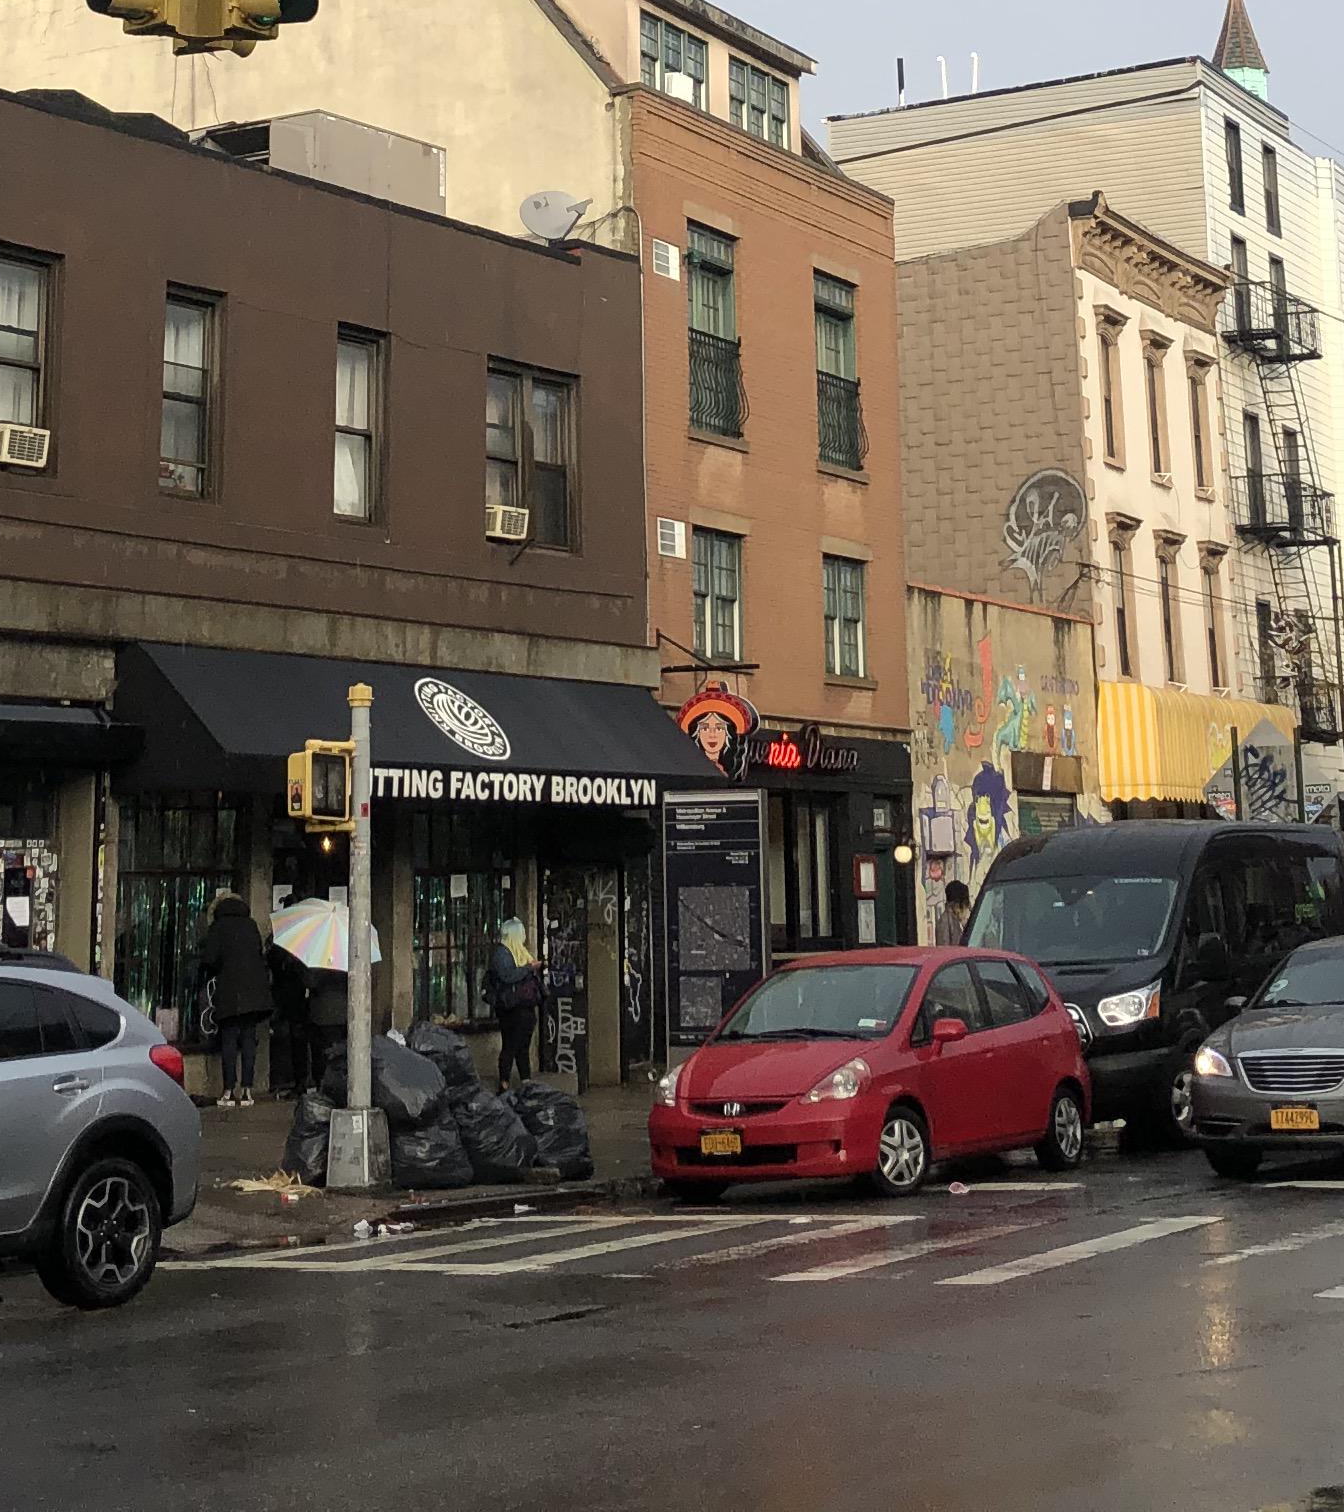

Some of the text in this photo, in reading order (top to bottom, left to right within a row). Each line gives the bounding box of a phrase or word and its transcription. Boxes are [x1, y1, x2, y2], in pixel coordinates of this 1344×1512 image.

[418, 683, 451, 731] KNITTING
[437, 684, 498, 733] FACTORY
[450, 771, 546, 802] FACTORY
[551, 775, 656, 806] BROOKLYN
